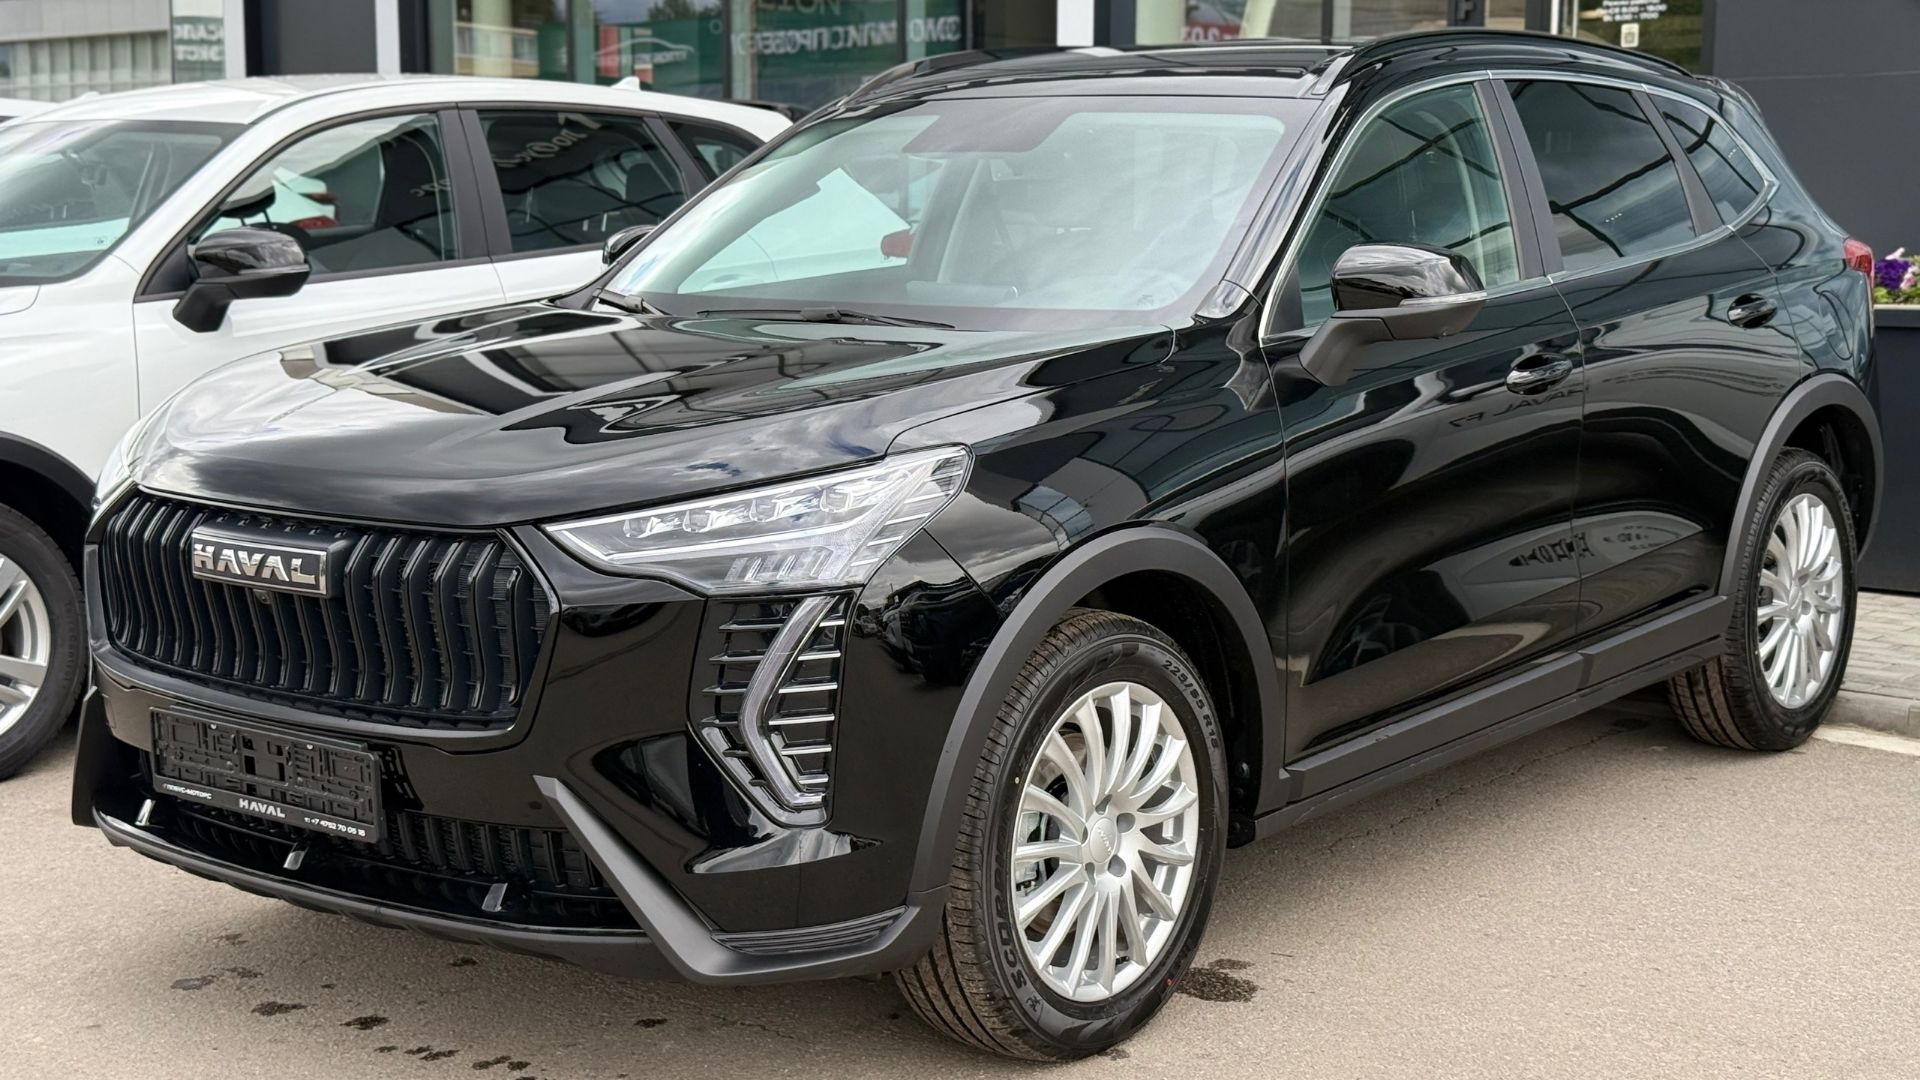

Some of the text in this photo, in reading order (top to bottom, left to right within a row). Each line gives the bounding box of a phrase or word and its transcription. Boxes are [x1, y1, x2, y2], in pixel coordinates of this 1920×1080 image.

[194, 543, 316, 585] HAVAL
[239, 798, 286, 818] HAVAL
[337, 824, 346, 832] 70
